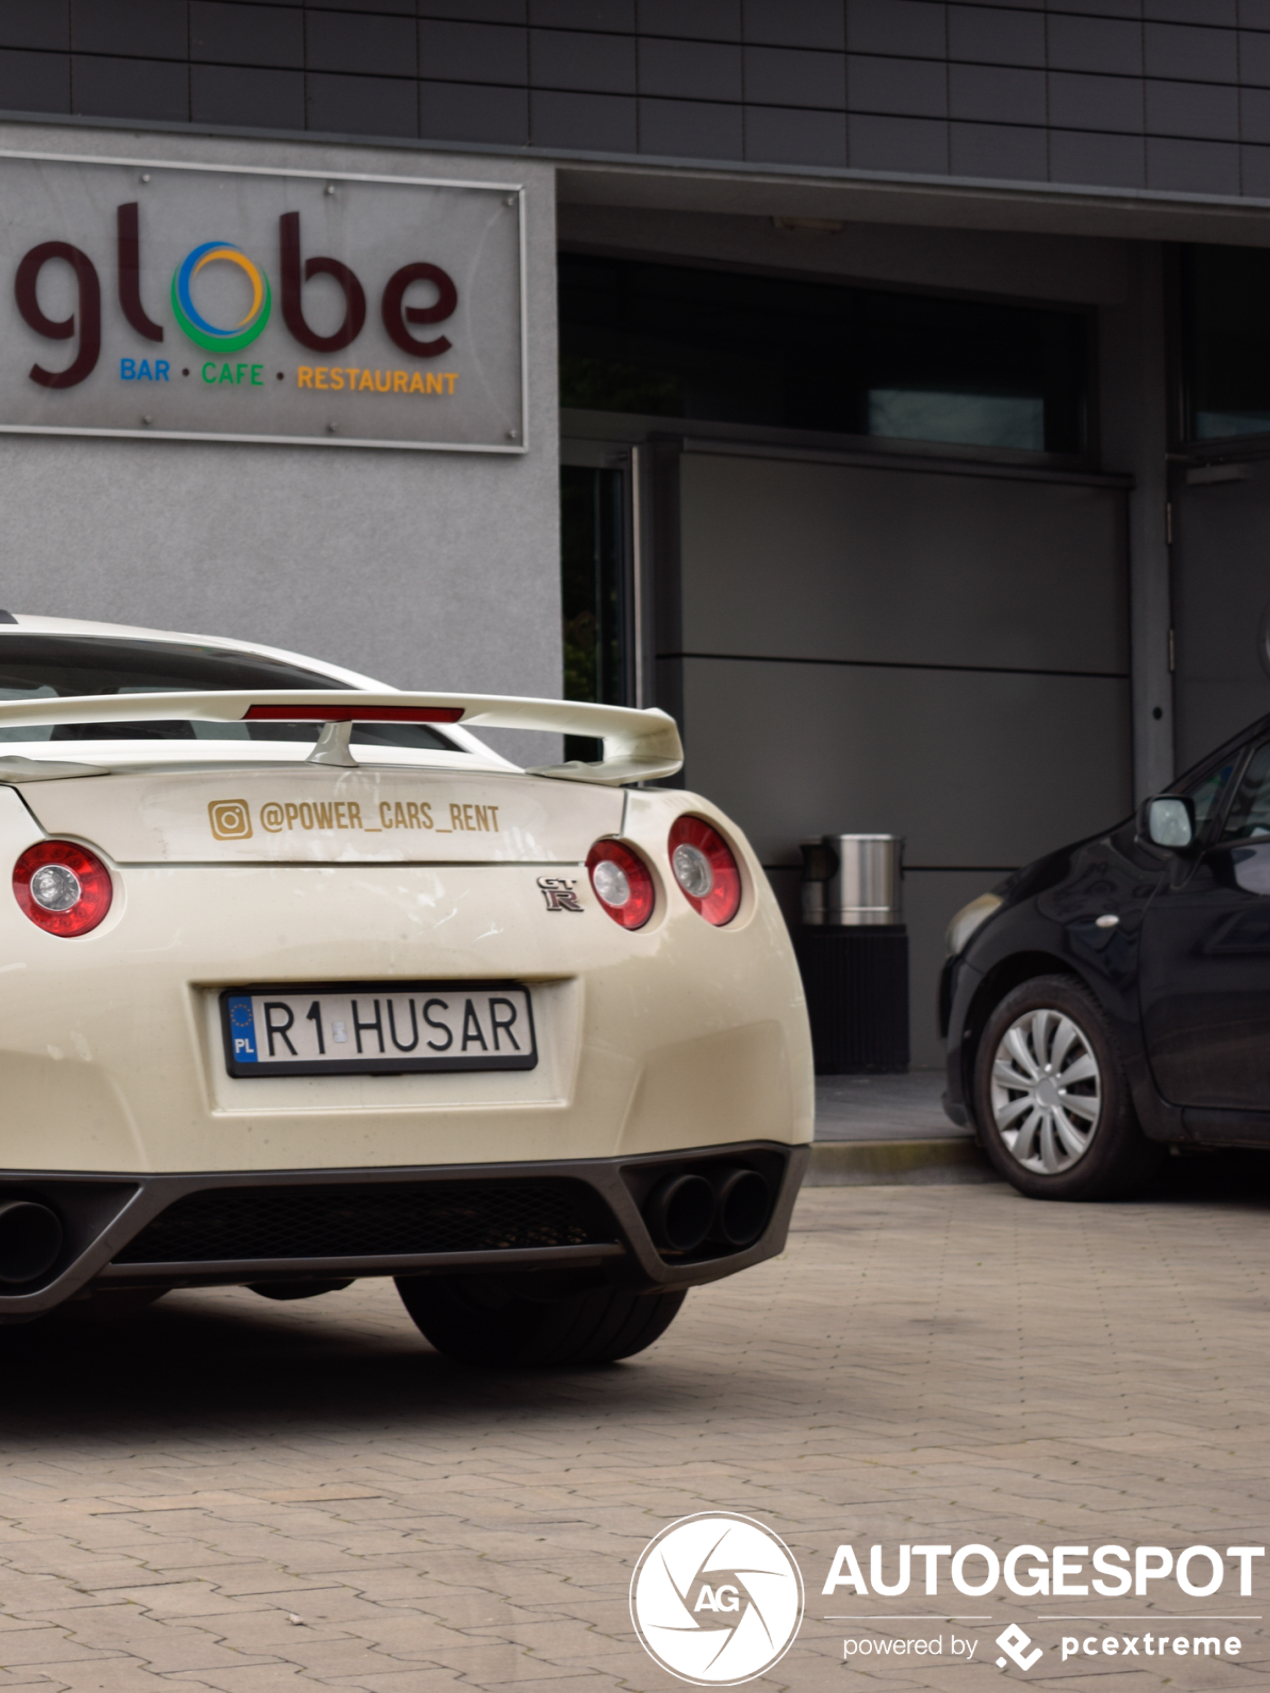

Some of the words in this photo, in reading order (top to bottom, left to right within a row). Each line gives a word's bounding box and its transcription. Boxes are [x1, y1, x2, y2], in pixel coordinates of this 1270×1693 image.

[14, 201, 458, 389] globe
[120, 358, 170, 382] BAR
[201, 362, 265, 386] CAFE
[297, 366, 459, 396] RESTAURANT
[259, 801, 500, 834] @POWER_CARS_RENT
[263, 1001, 327, 1056] R1
[351, 997, 522, 1055] HUSAR
[235, 1038, 255, 1054] PL
